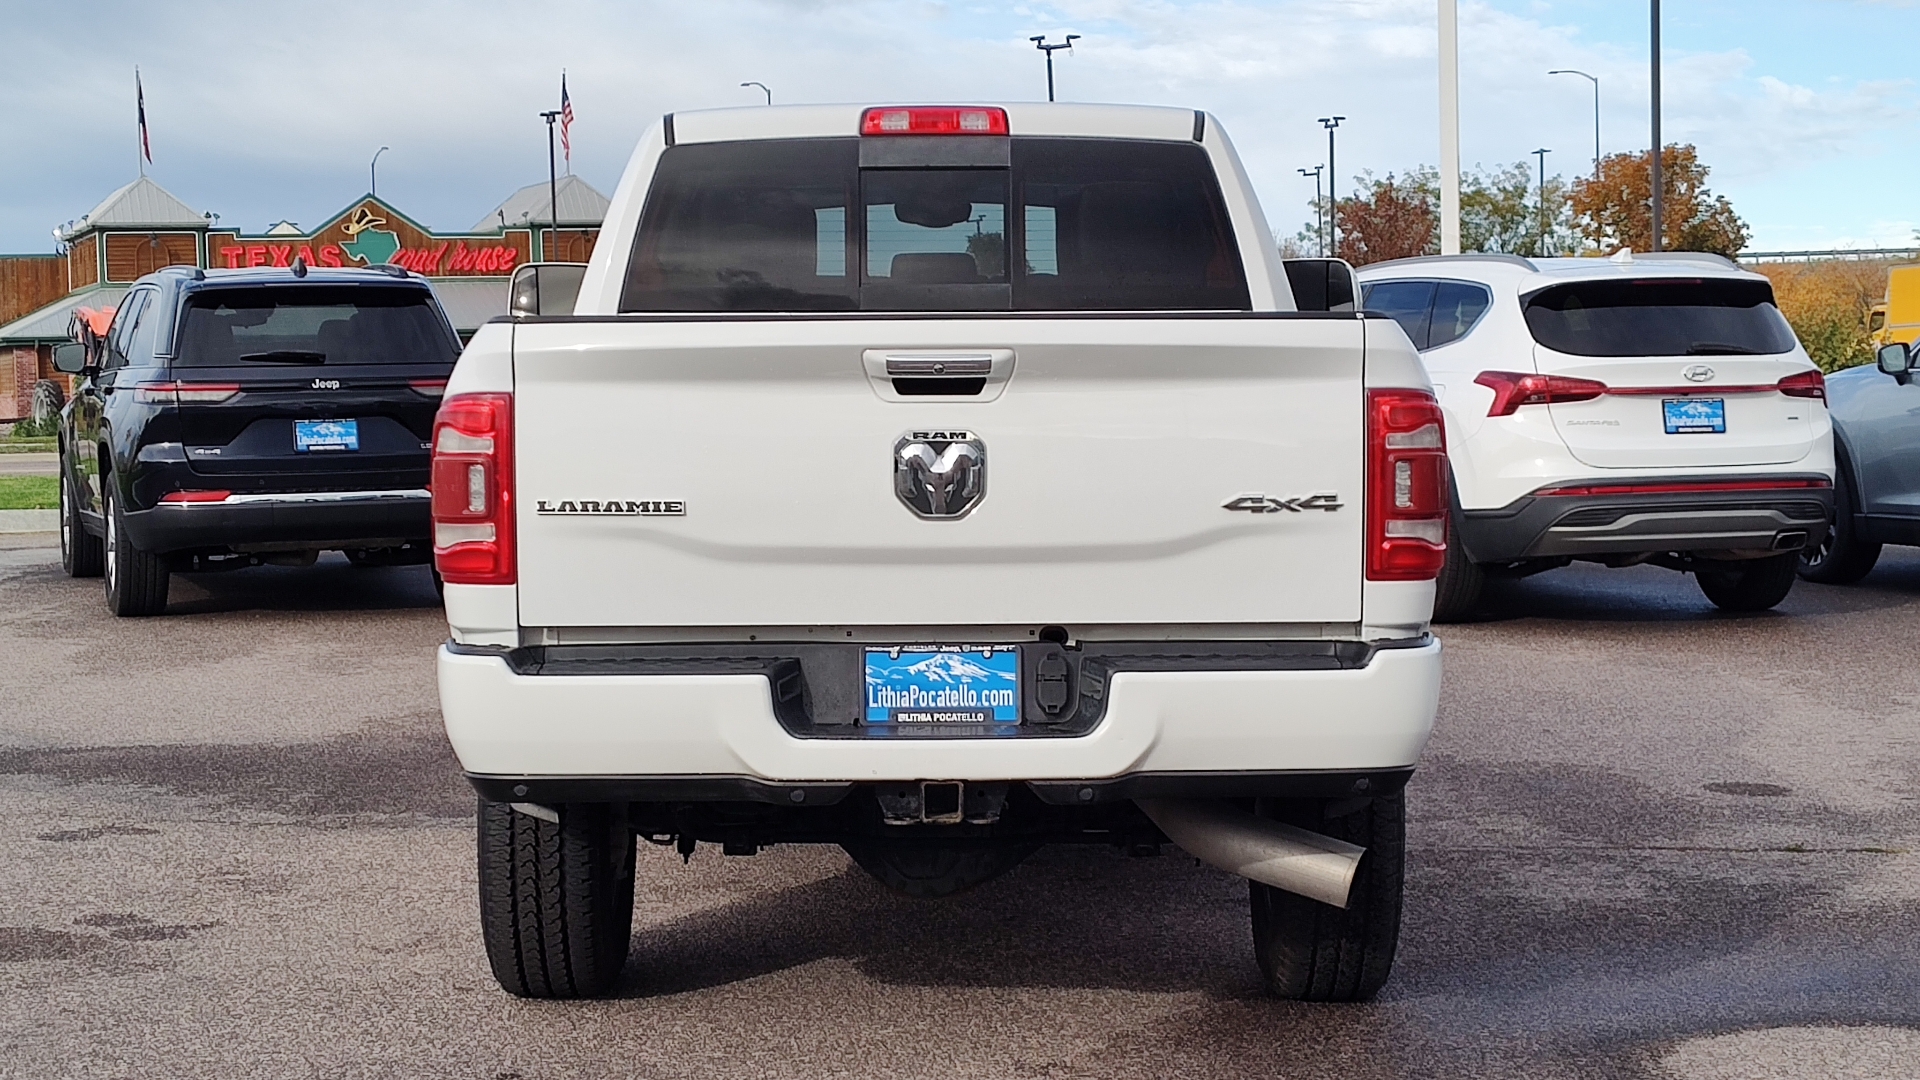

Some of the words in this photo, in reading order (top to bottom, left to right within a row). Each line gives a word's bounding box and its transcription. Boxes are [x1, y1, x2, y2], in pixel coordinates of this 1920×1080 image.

[221, 245, 343, 269] TEXAS
[389, 241, 449, 272] road
[447, 241, 517, 272] house
[311, 378, 340, 390] Jeep
[912, 432, 967, 440] RAM
[536, 500, 684, 514] LARAMIE
[868, 684, 1014, 709] LithiaPocatello.com
[933, 712, 984, 722] POCATELLO
